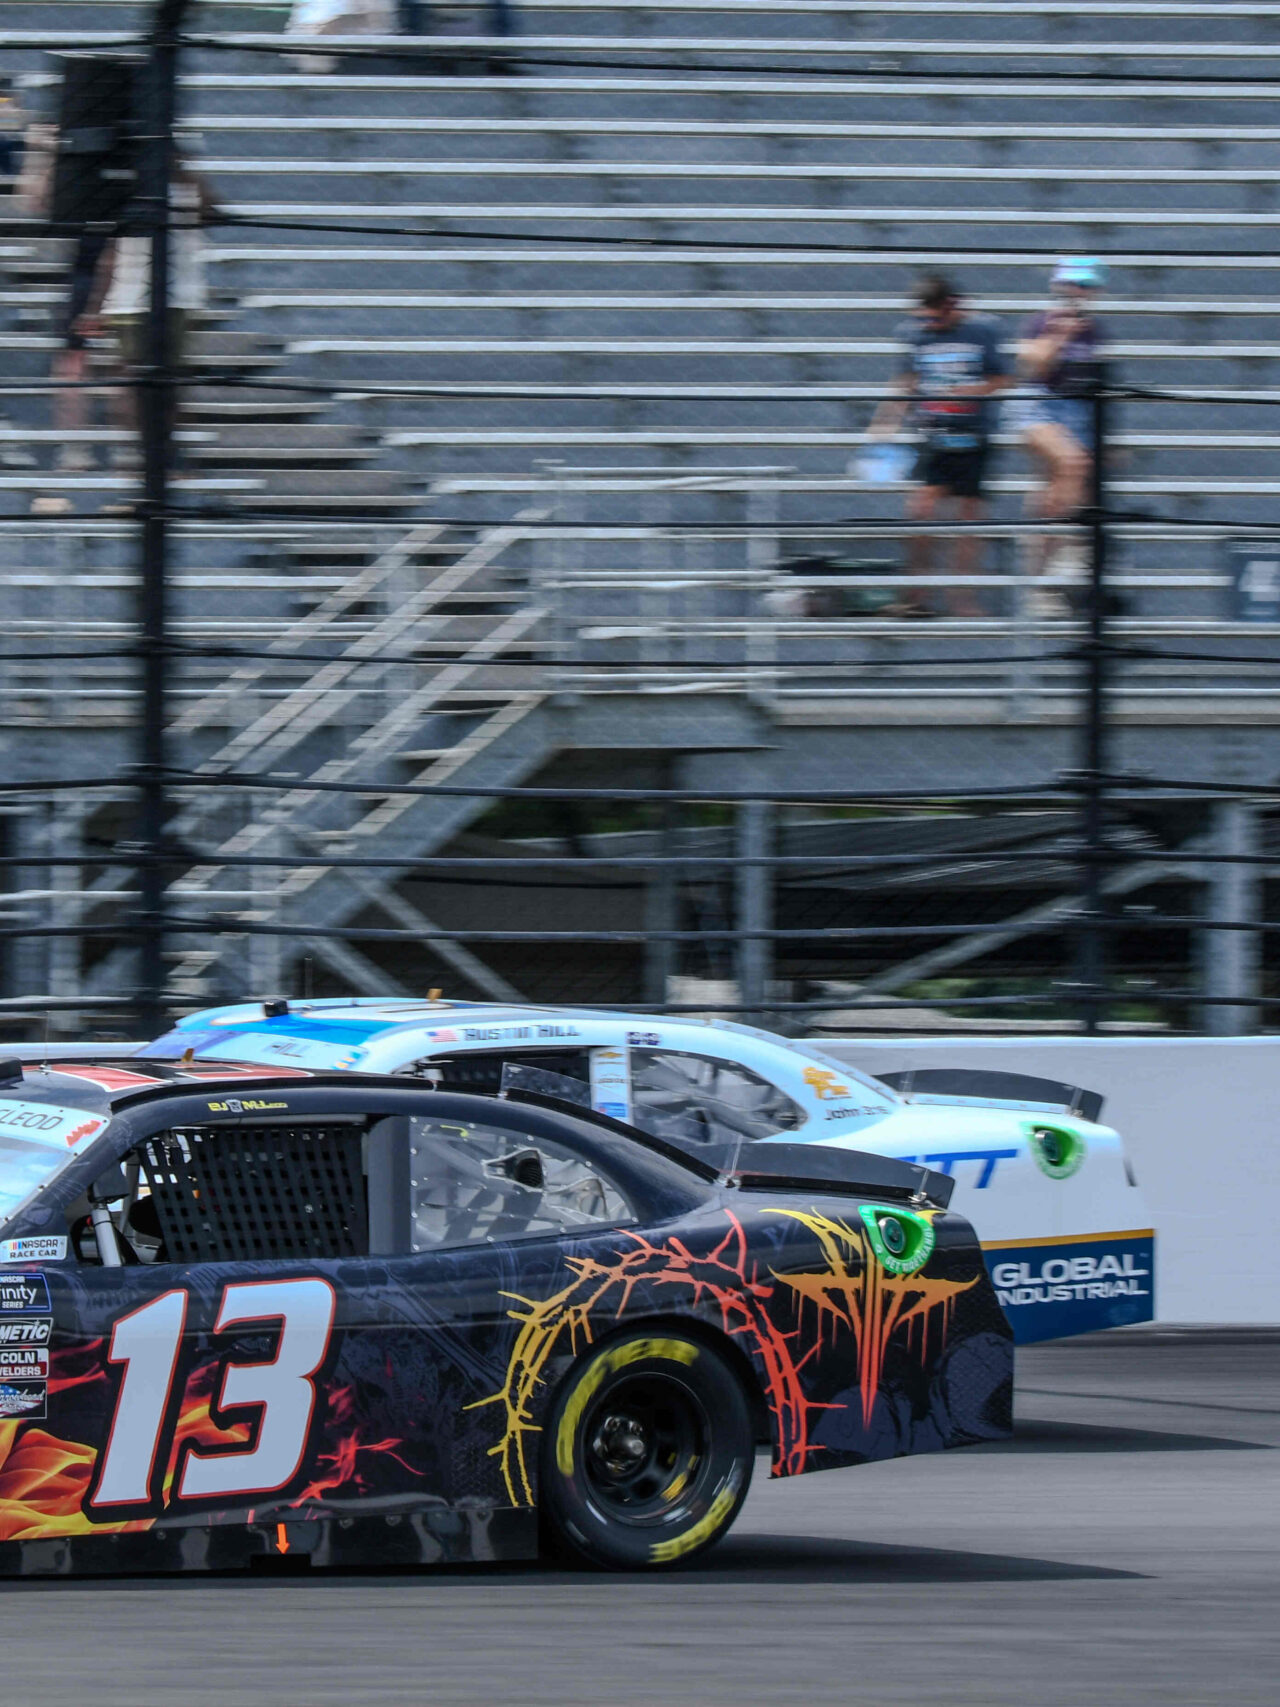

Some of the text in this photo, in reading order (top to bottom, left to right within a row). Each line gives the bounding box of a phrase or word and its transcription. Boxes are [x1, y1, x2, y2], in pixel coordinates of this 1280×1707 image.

[898, 1149, 1018, 1189] TT
[10, 1249, 57, 1258] RACE CAR
[22, 1239, 58, 1249] NASCAR
[992, 1254, 1149, 1288] GLOBAL
[2, 1301, 24, 1309] SERIES
[995, 1279, 1149, 1306] NDUSTRIAL
[91, 1277, 336, 1507] 13
